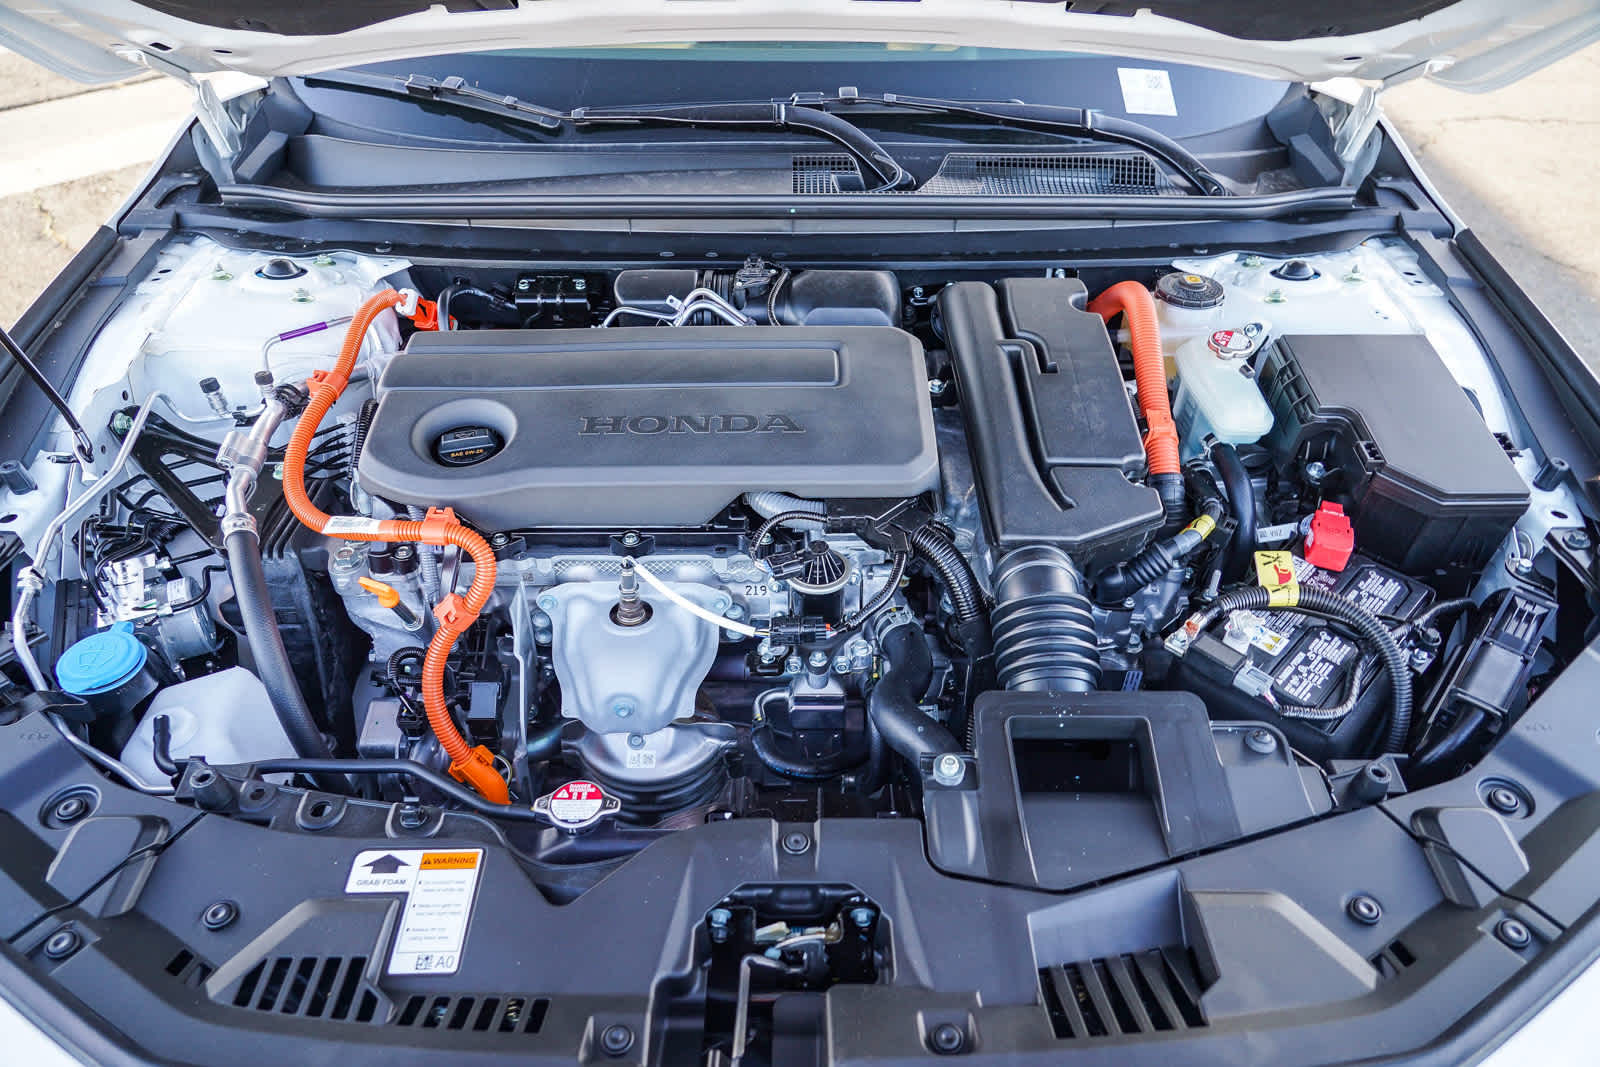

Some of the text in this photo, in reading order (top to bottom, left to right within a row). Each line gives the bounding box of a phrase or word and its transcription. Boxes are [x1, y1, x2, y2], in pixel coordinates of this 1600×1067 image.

[577, 415, 807, 436] HONDA
[744, 585, 768, 596] 219
[433, 856, 476, 865] WARNING
